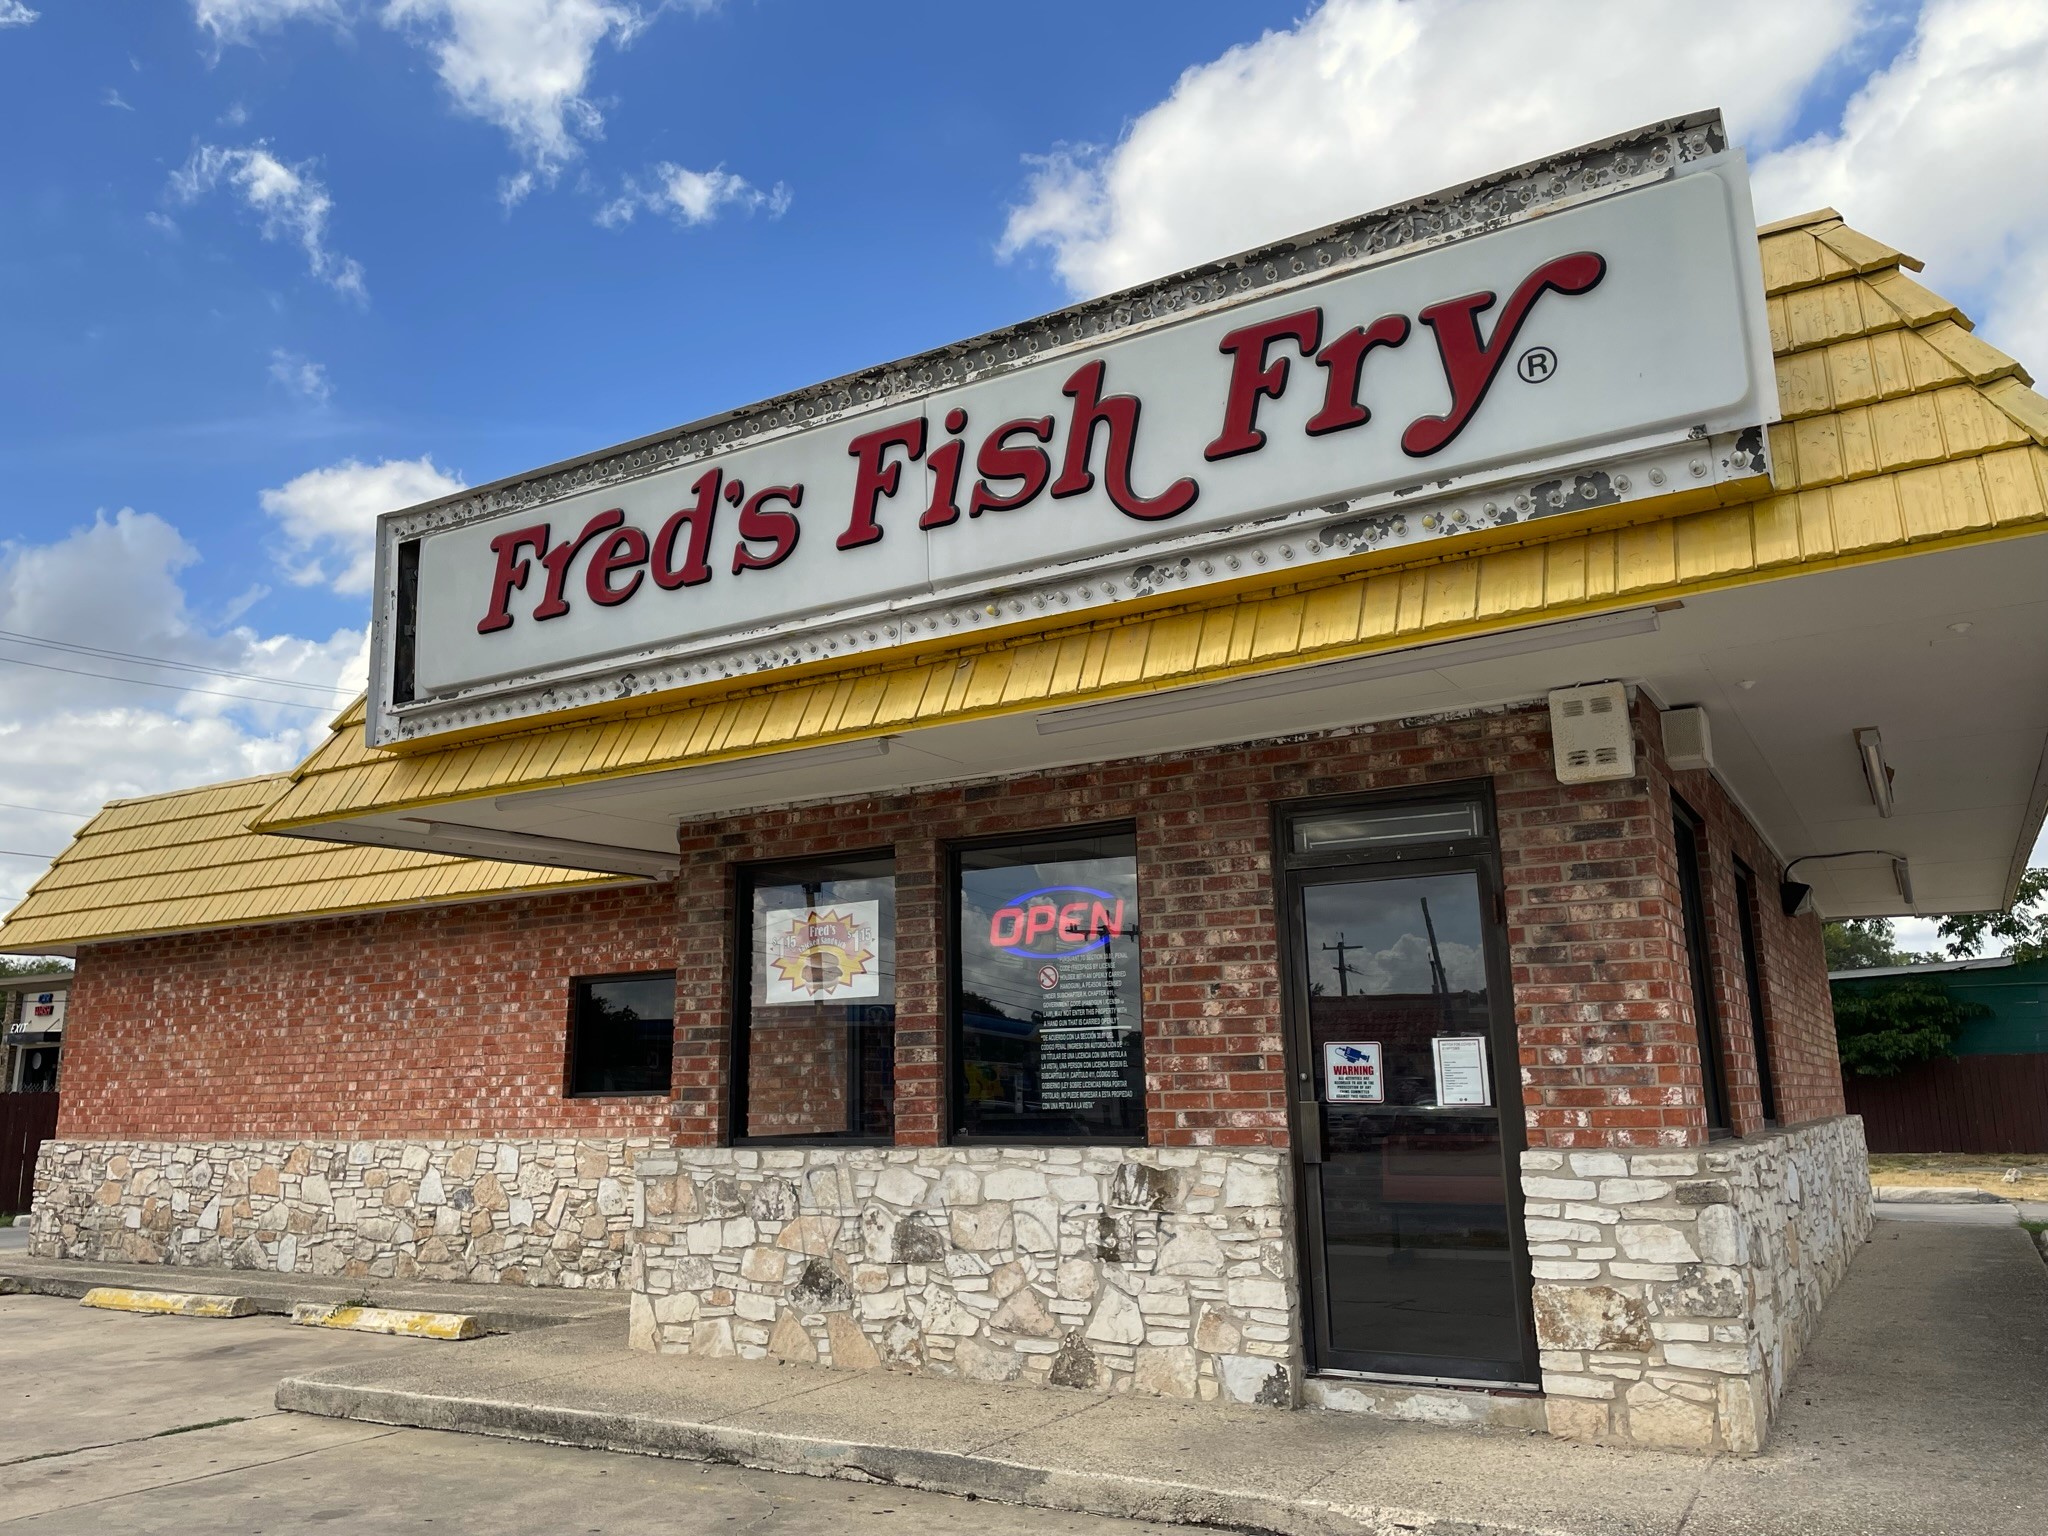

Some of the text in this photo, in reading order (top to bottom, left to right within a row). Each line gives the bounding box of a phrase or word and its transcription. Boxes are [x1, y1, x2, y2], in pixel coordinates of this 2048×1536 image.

[477, 466, 803, 635] Fred's
[837, 359, 1201, 551] Fish
[1203, 250, 1607, 460] Fry
[990, 898, 1124, 947] OPEN
[810, 924, 836, 937] Fred's
[10, 1022, 28, 1033] EXIT
[1333, 1065, 1374, 1076] WARNING
